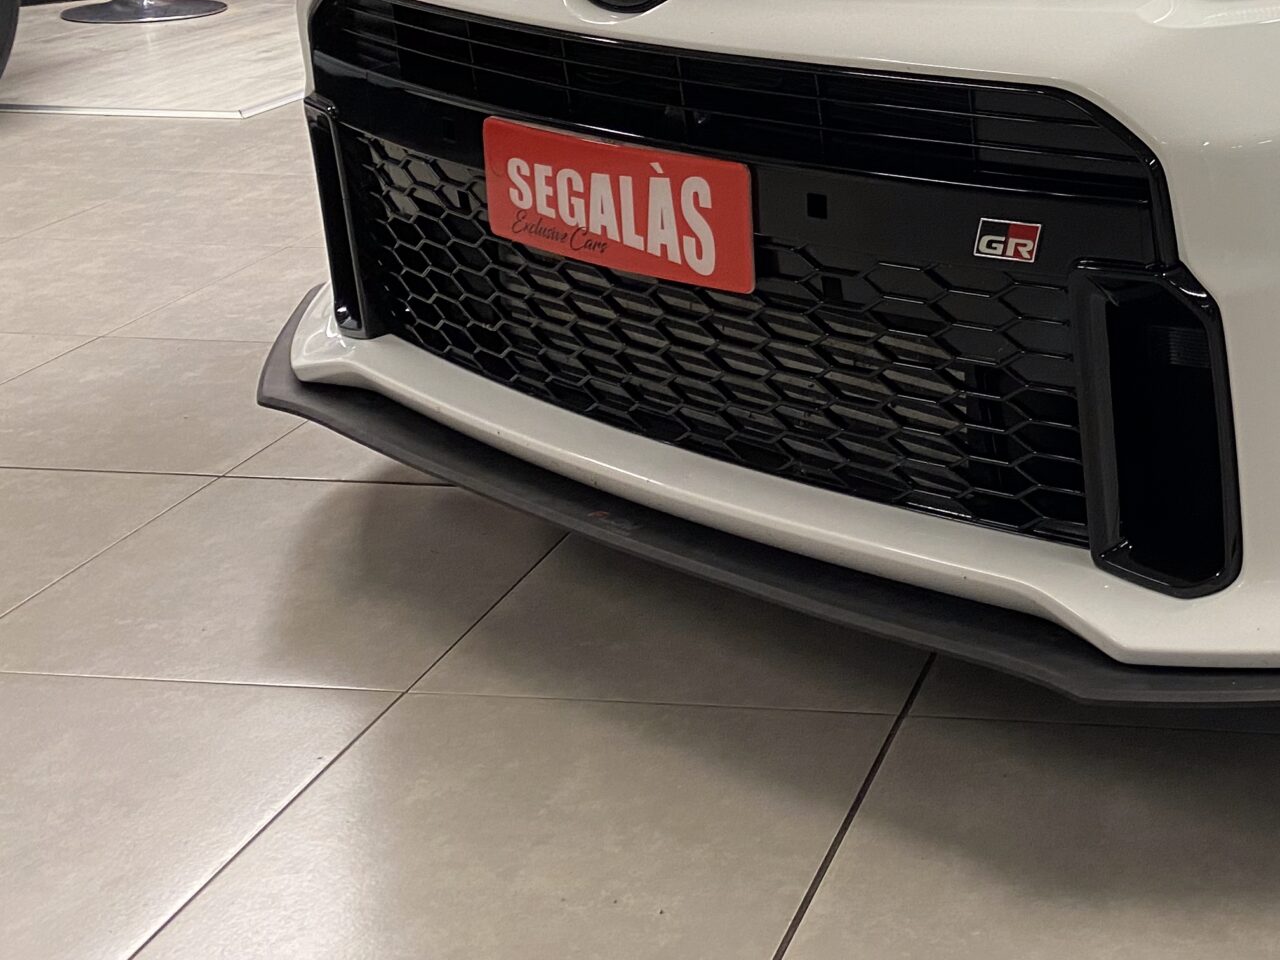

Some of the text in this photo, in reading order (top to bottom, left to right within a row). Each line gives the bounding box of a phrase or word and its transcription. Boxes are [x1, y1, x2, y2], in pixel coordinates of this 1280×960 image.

[507, 157, 716, 276] SEGALÀS
[511, 209, 608, 254] Exclusive Cars
[978, 234, 1034, 259] GR
